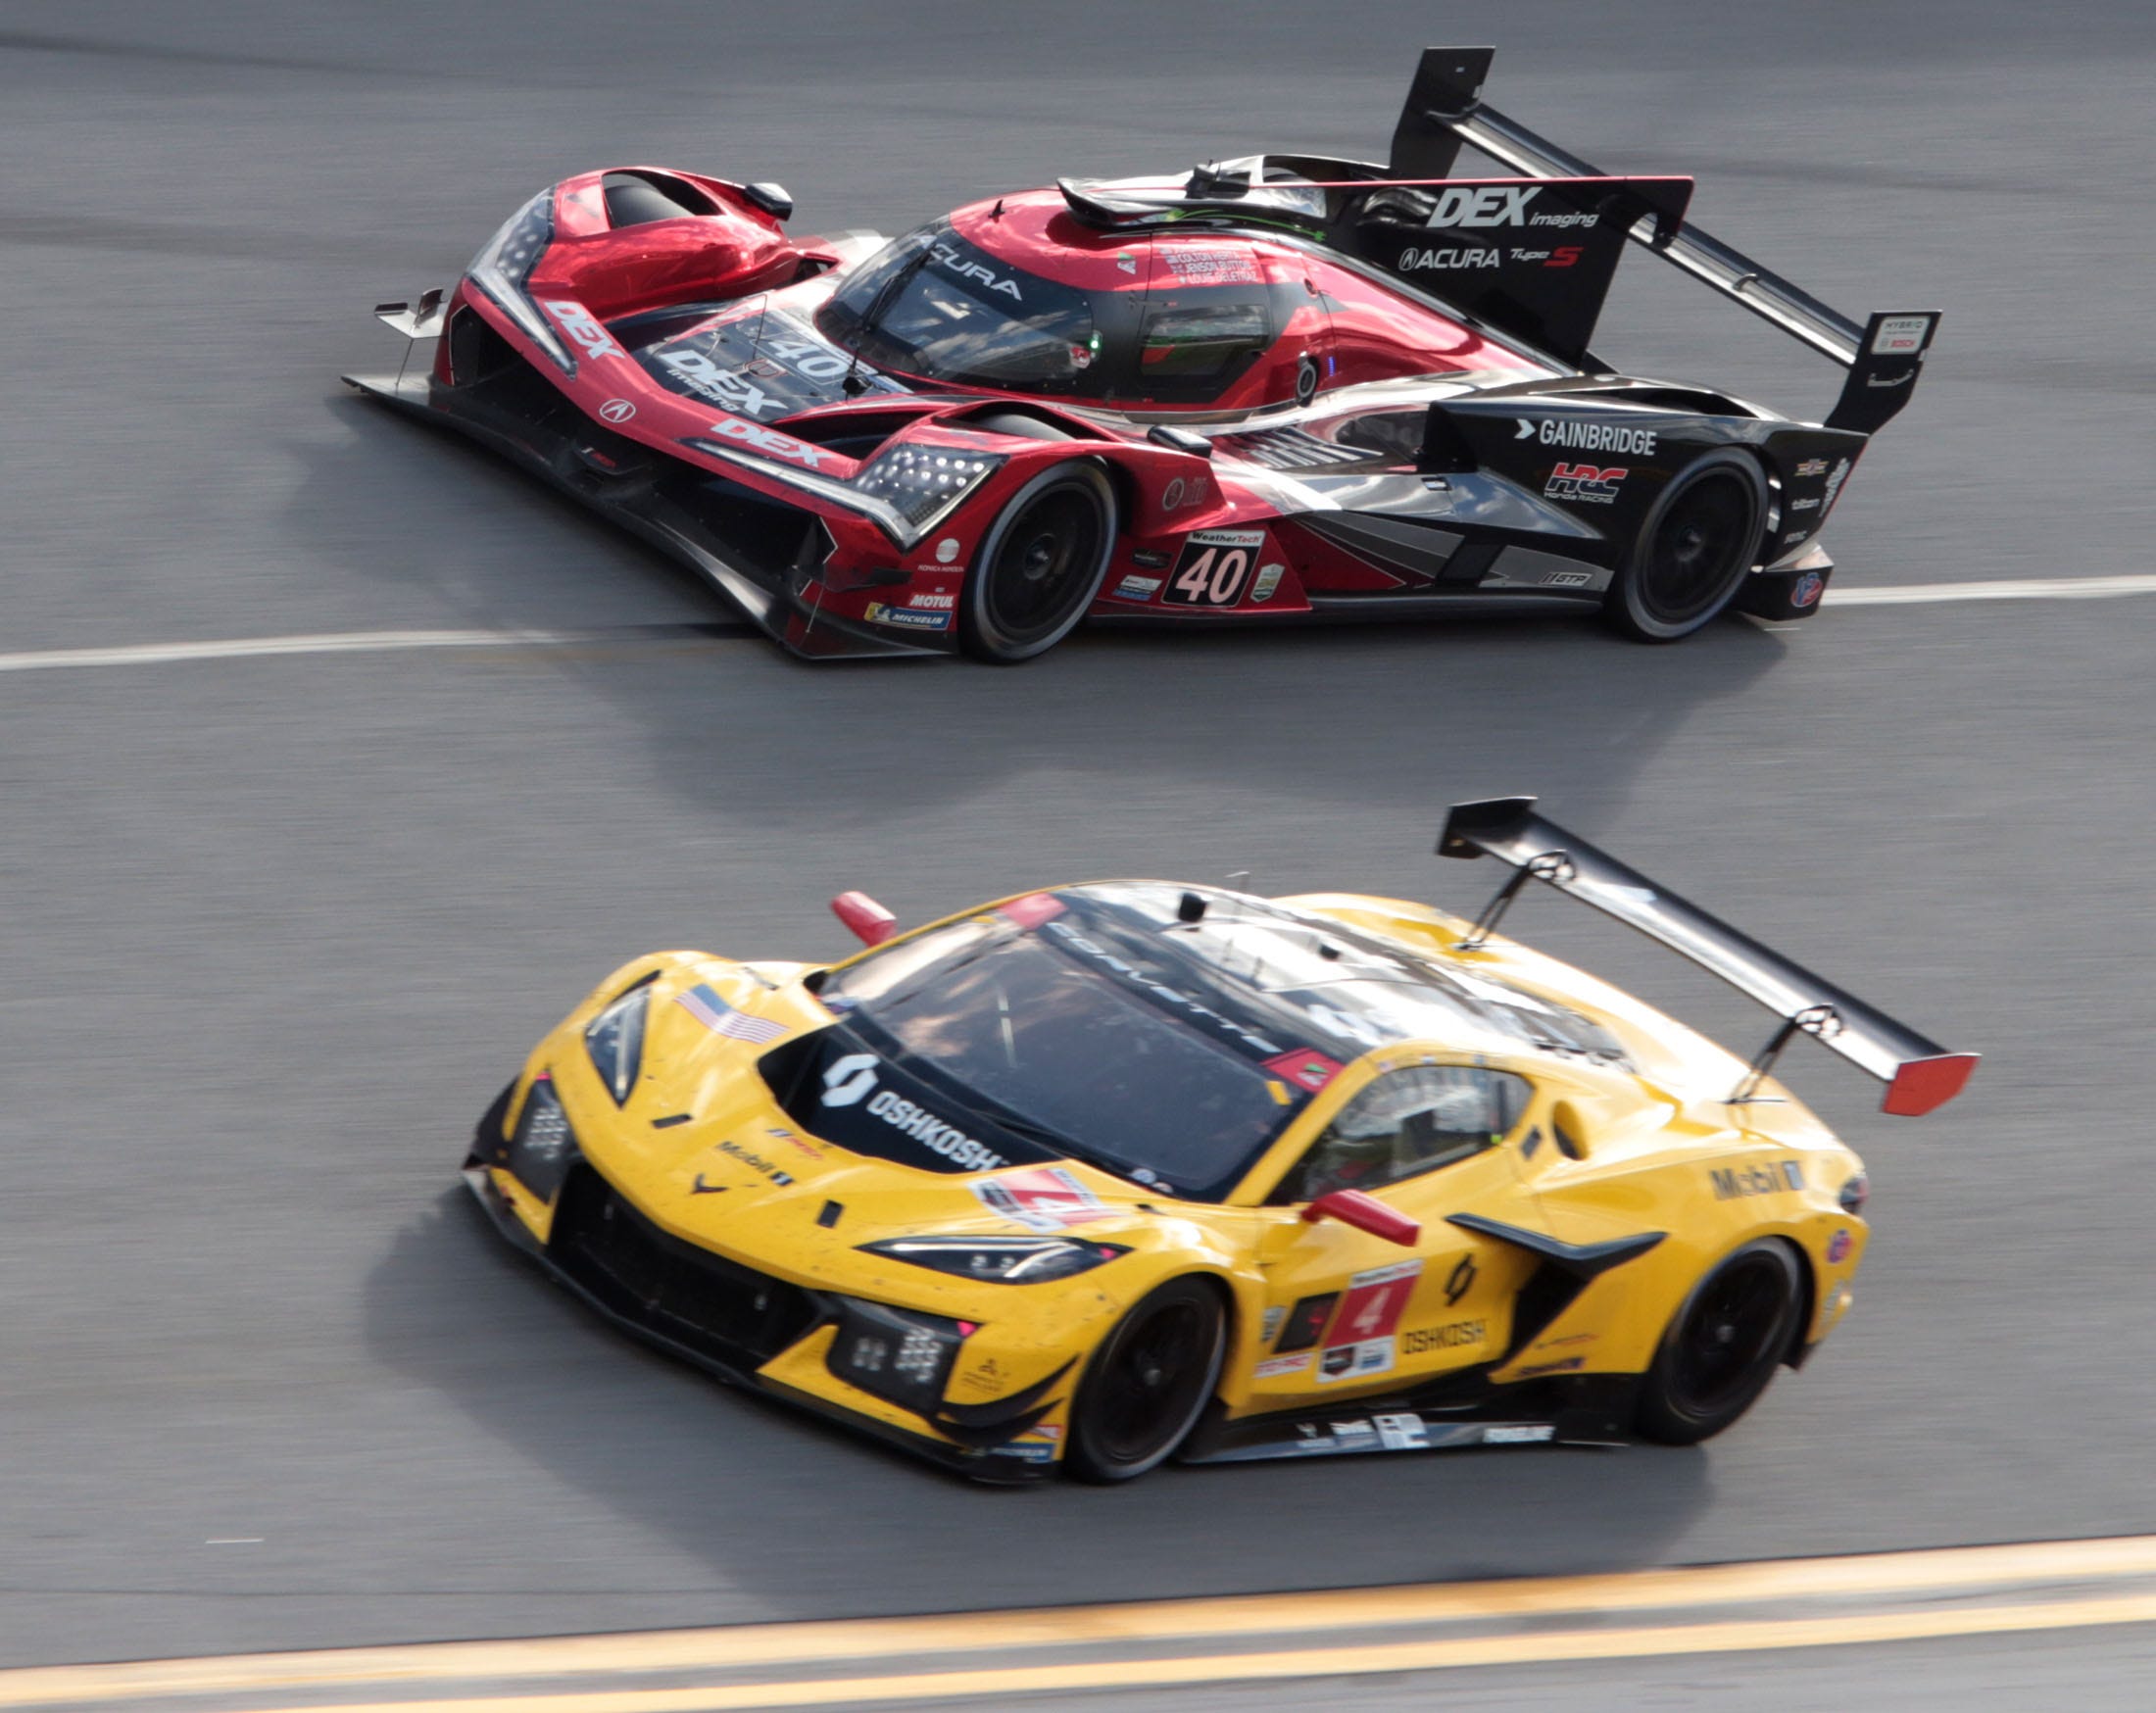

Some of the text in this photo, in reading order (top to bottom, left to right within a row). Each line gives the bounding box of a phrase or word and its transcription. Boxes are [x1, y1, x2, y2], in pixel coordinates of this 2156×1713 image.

[1426, 186, 1599, 228] DEX imaging
[913, 235, 1022, 301] ACURA
[1415, 249, 1500, 269] ACURA
[1510, 247, 1584, 267] Type S
[544, 301, 625, 361] DEX
[768, 342, 850, 377] 40
[659, 350, 788, 416] DEX
[710, 418, 833, 467] DEX
[1540, 419, 1657, 457] GAINBRIDGE
[1544, 463, 1629, 497] HRC
[1544, 491, 1578, 501] Honda
[1192, 532, 1261, 544] WeatherTech
[1176, 548, 1248, 604] 40
[1554, 573, 1588, 585] GTP
[892, 612, 944, 626] MICHELIN
[909, 594, 954, 608] MOTUL
[866, 1091, 1002, 1172] OSHKOSH
[715, 1141, 776, 1173] Mobil
[1709, 1163, 1782, 1200] Mobil
[1350, 1287, 1392, 1335] 4
